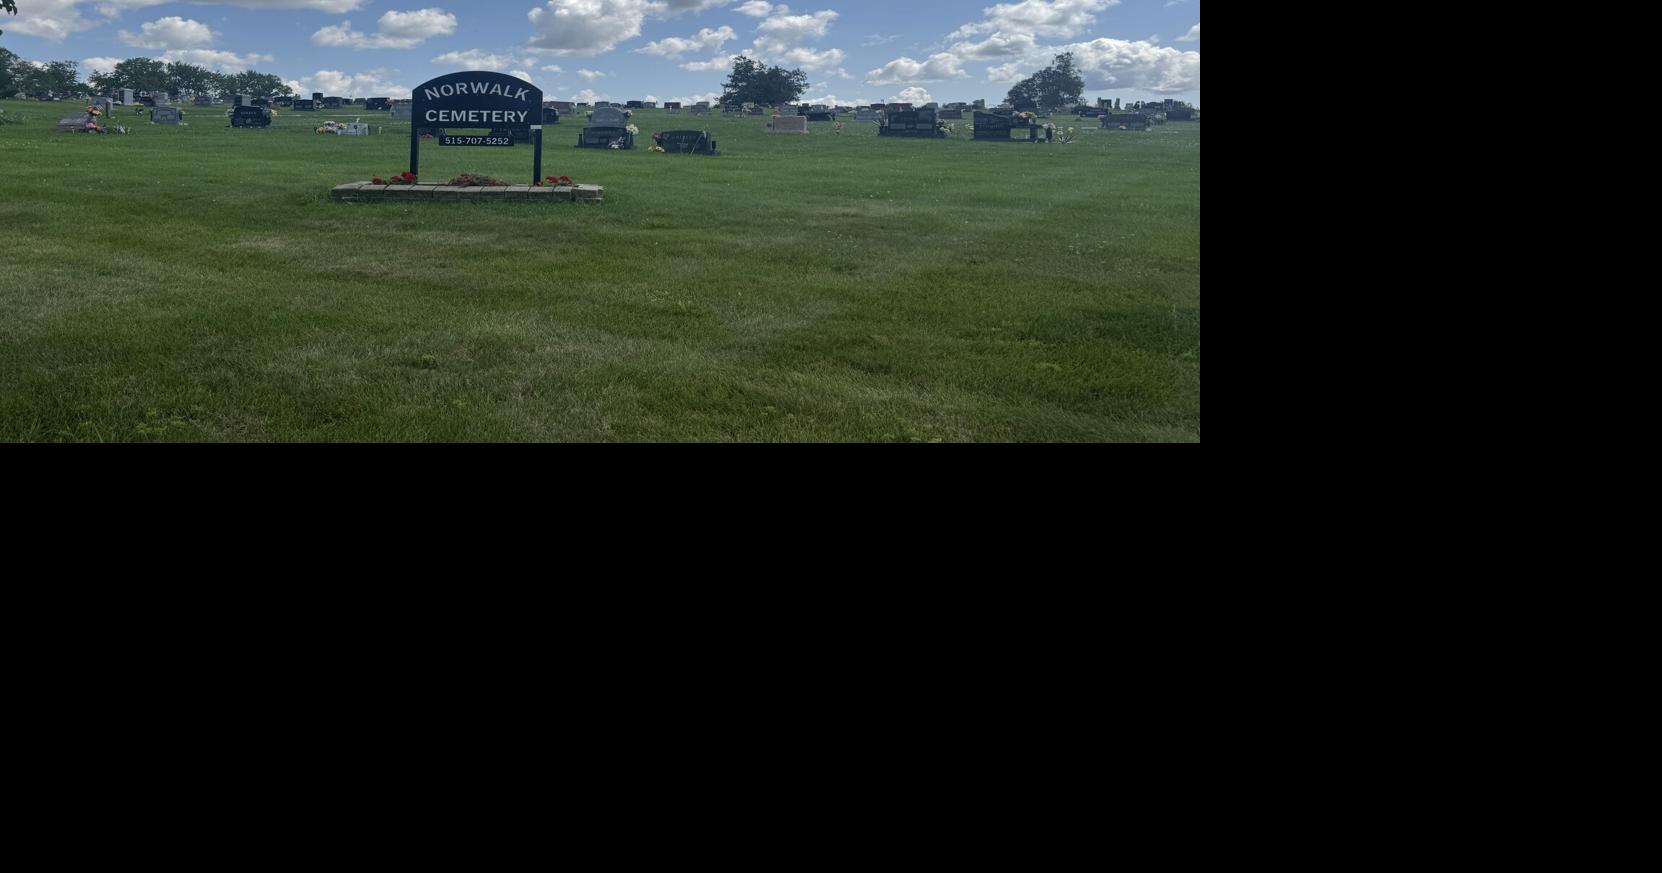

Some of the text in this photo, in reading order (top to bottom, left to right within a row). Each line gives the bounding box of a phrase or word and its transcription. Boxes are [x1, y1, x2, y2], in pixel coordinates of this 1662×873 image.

[424, 82, 530, 101] NORWALK
[425, 109, 528, 122] CEMETERY
[444, 137, 509, 145] 515-707-5252
